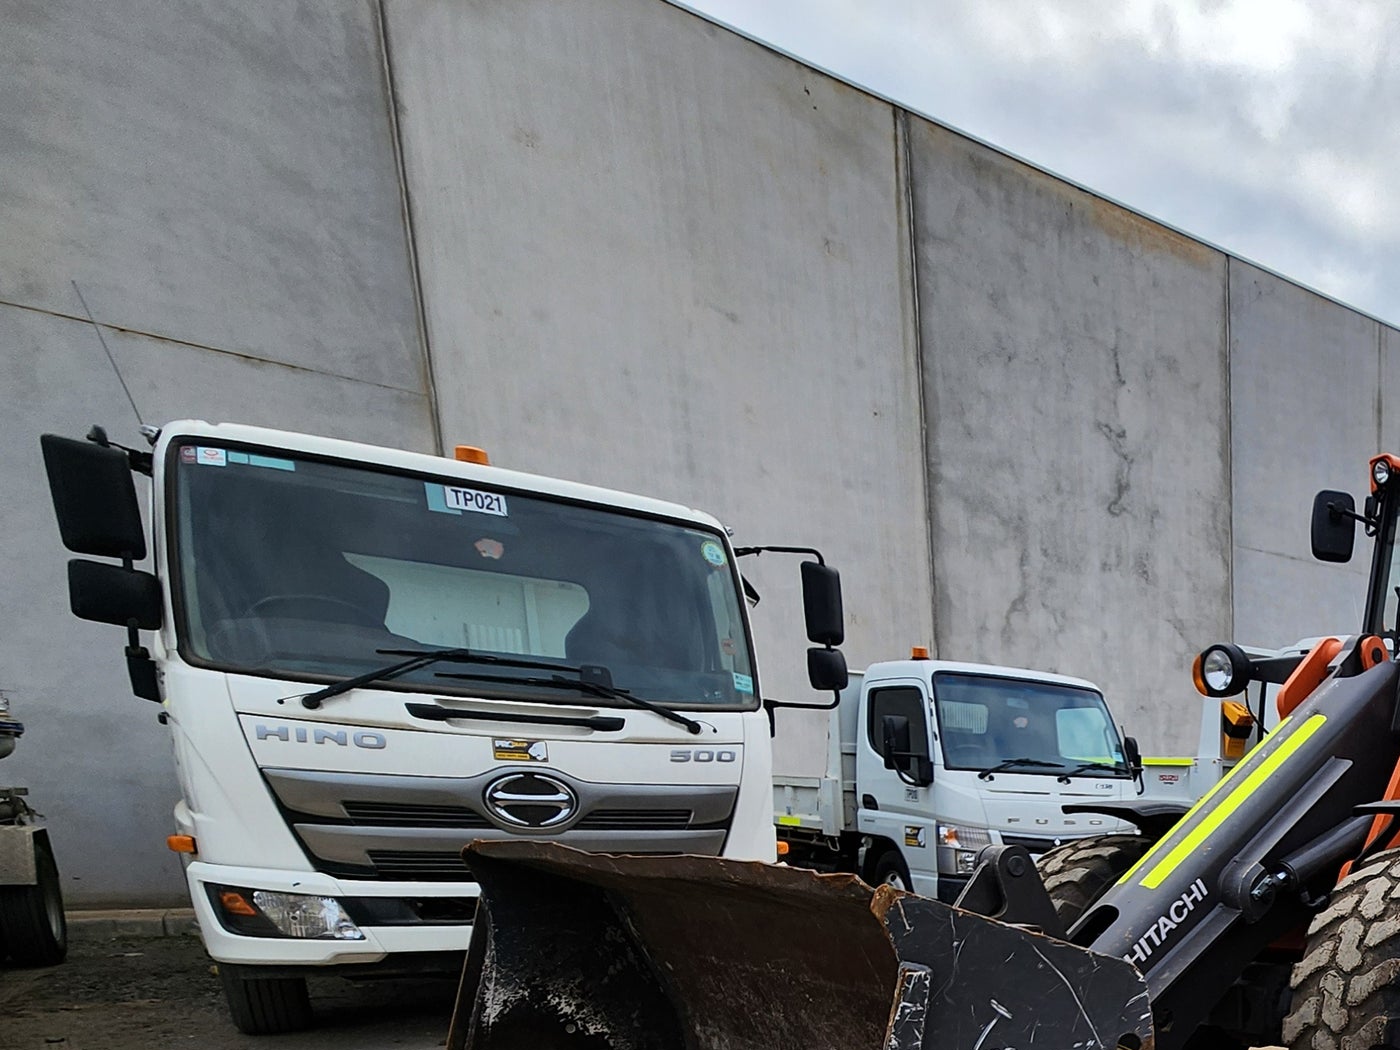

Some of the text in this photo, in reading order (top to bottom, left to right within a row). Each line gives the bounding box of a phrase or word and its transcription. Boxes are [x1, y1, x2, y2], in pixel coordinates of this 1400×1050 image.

[450, 488, 502, 513] TP021
[256, 725, 387, 749] HINO
[670, 750, 736, 762] 500
[1123, 878, 1209, 963] HITACHI
